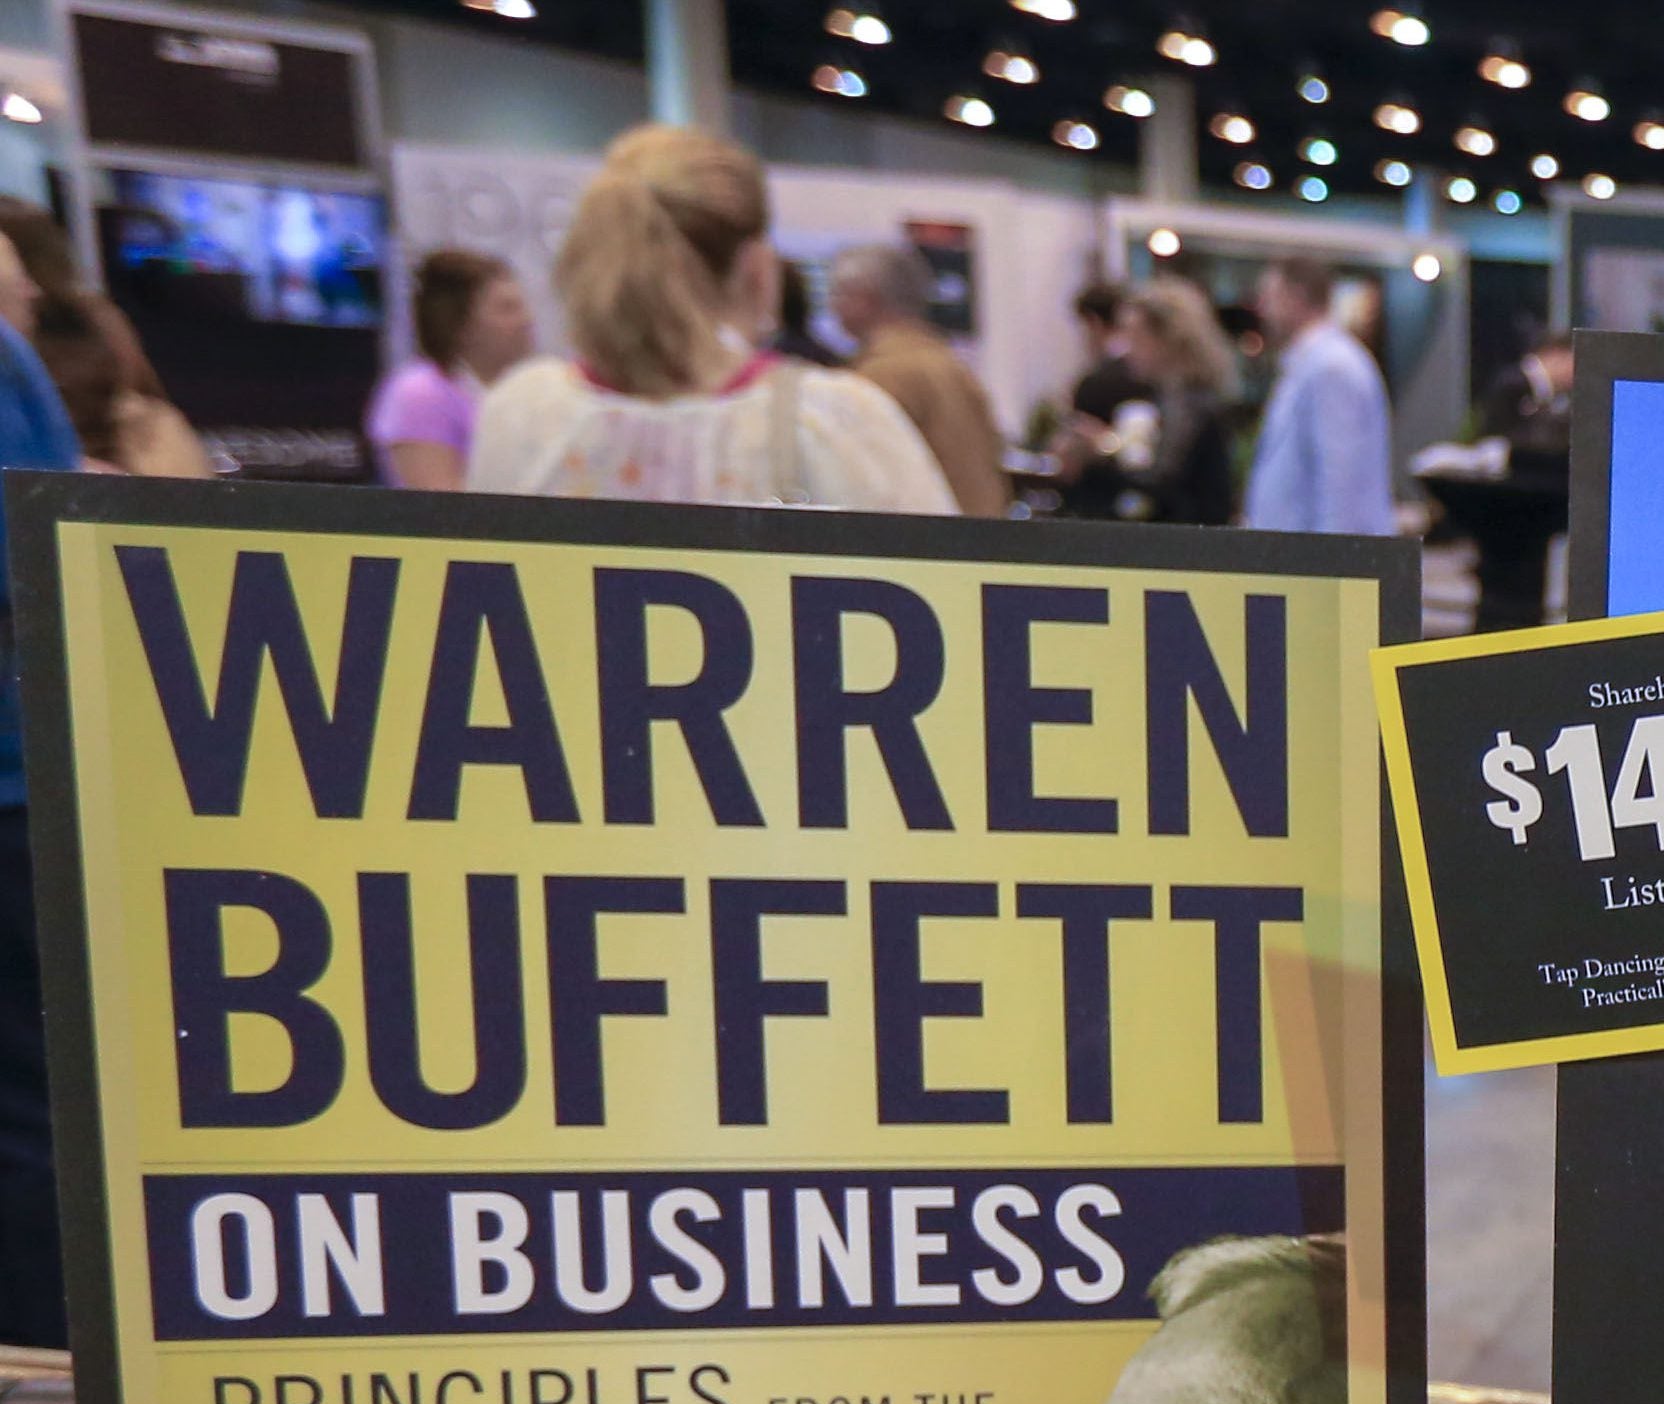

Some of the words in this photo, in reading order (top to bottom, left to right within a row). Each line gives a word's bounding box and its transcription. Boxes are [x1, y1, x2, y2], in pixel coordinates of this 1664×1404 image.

[113, 545, 1288, 837] WARREN
[165, 867, 1305, 1132] BUFFETT
[1539, 963, 1578, 986] Tap
[190, 1189, 381, 1320] ON
[453, 1182, 1127, 1319] BUSINESS
